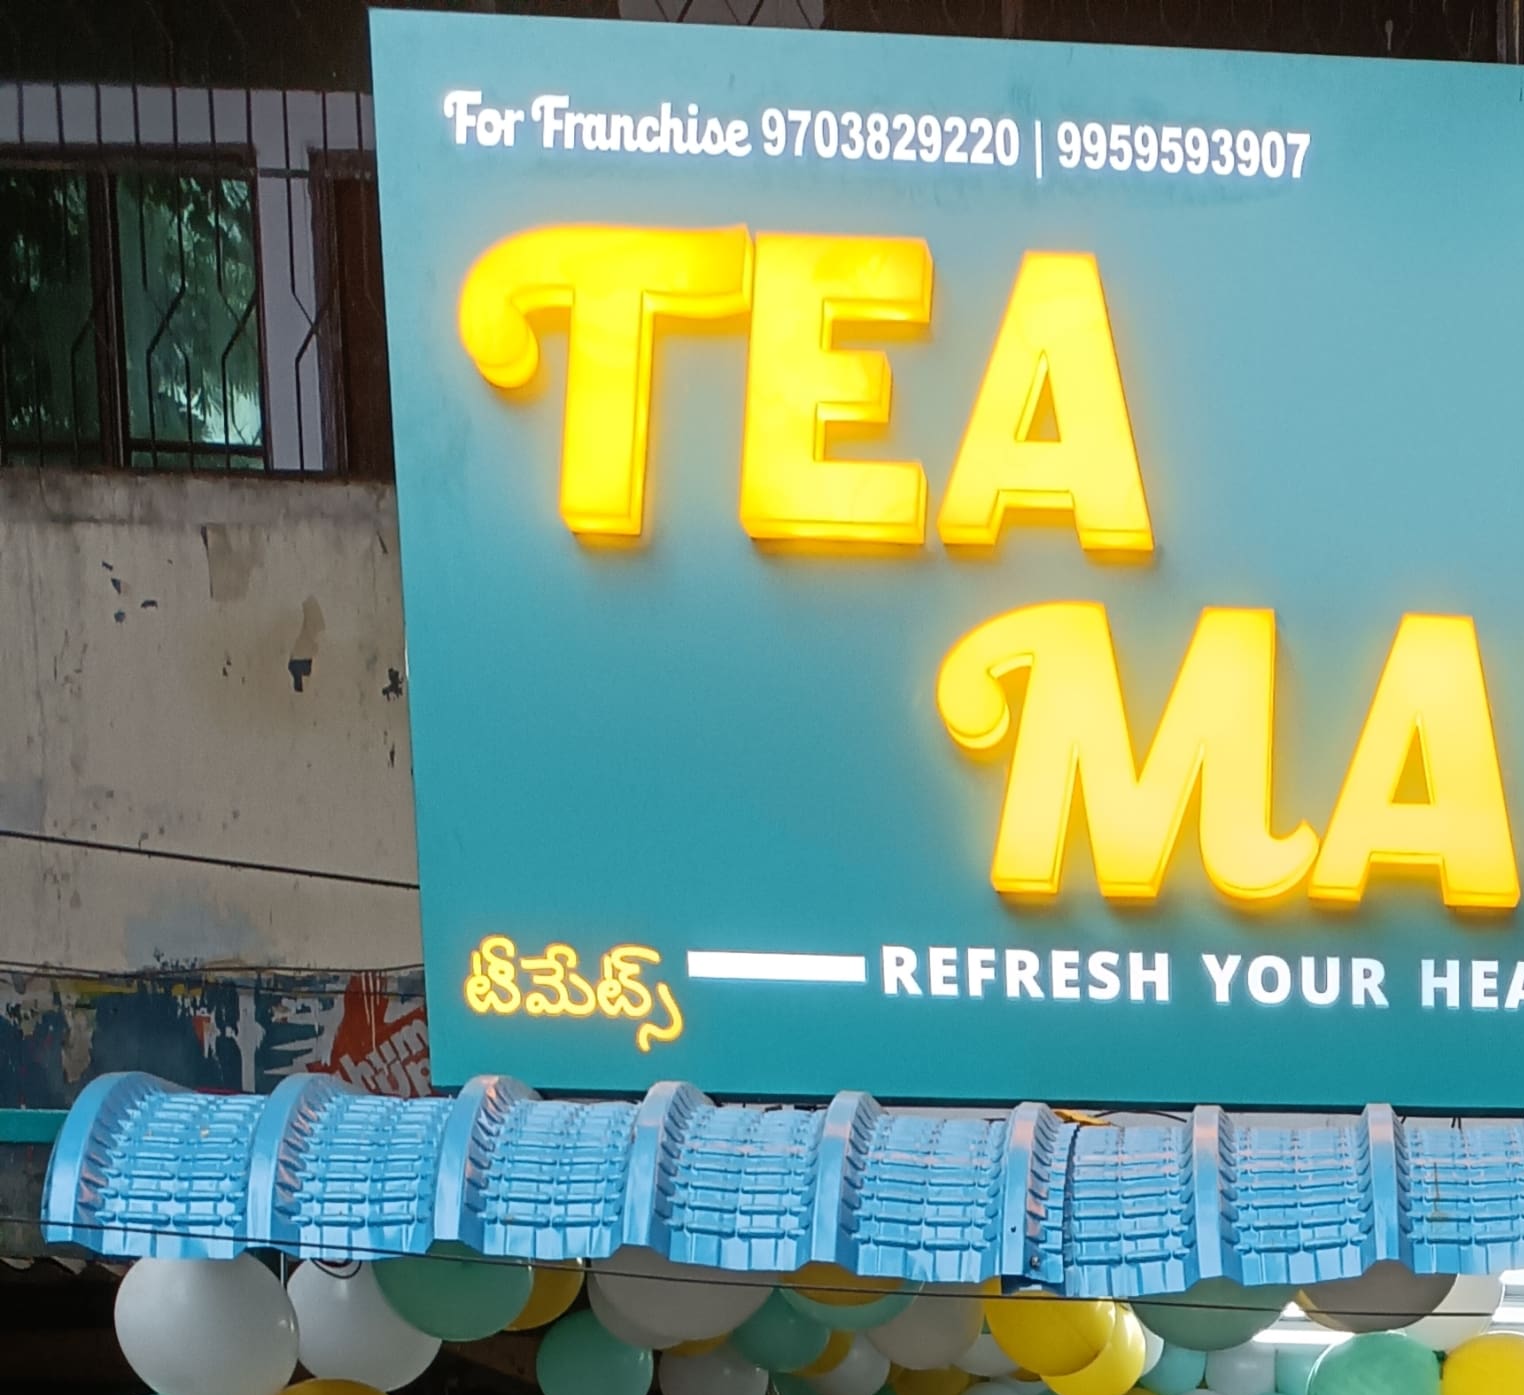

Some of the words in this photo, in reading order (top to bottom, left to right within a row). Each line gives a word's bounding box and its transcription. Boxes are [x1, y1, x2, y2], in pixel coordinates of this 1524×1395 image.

[443, 89, 525, 147] For
[531, 93, 752, 158] Franchise
[761, 108, 1019, 169] 9703829220
[1057, 121, 1312, 180] 9959593907
[458, 221, 1155, 553] TEA
[463, 934, 684, 1053] టీమేట్స్
[880, 944, 1171, 1003] REFRESH
[1201, 953, 1389, 1008] YOUR
